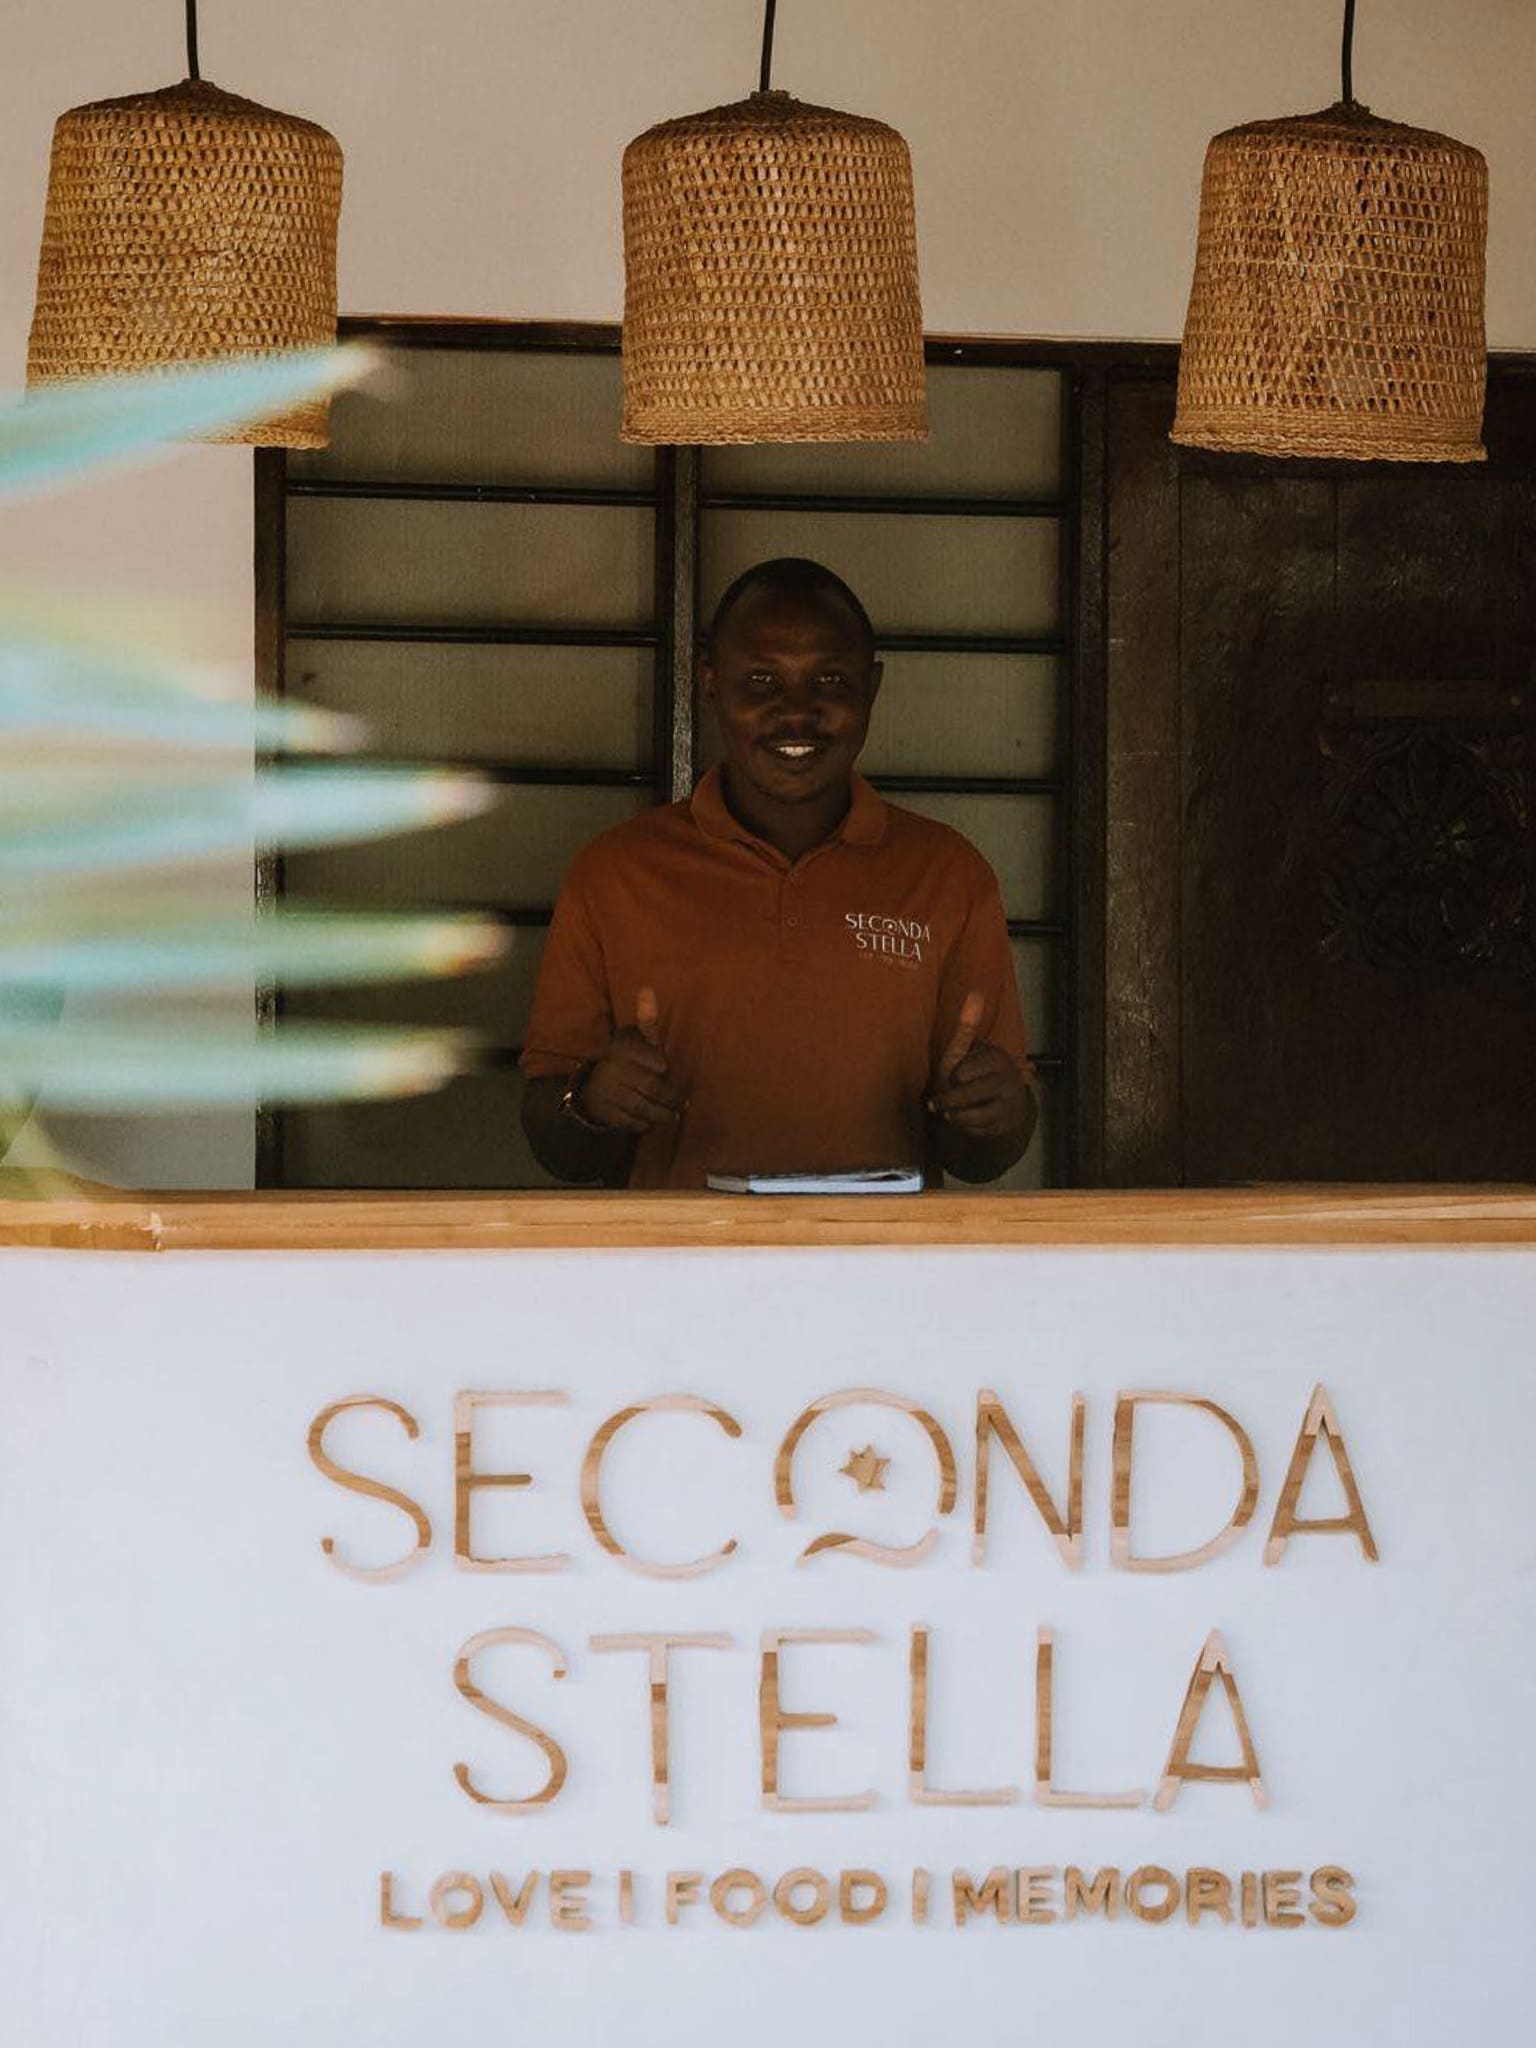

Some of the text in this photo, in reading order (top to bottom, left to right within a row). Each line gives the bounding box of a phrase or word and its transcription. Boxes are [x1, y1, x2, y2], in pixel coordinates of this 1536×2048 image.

[845, 912, 931, 943] SECONDA
[855, 932, 922, 962] STELLA
[307, 1383, 1381, 1584] SECONDA
[452, 1623, 1270, 1826] STELLA
[379, 1868, 593, 1930] LOVE
[665, 1866, 889, 1928] FOOD
[953, 1863, 1359, 1930] MEMORIES
